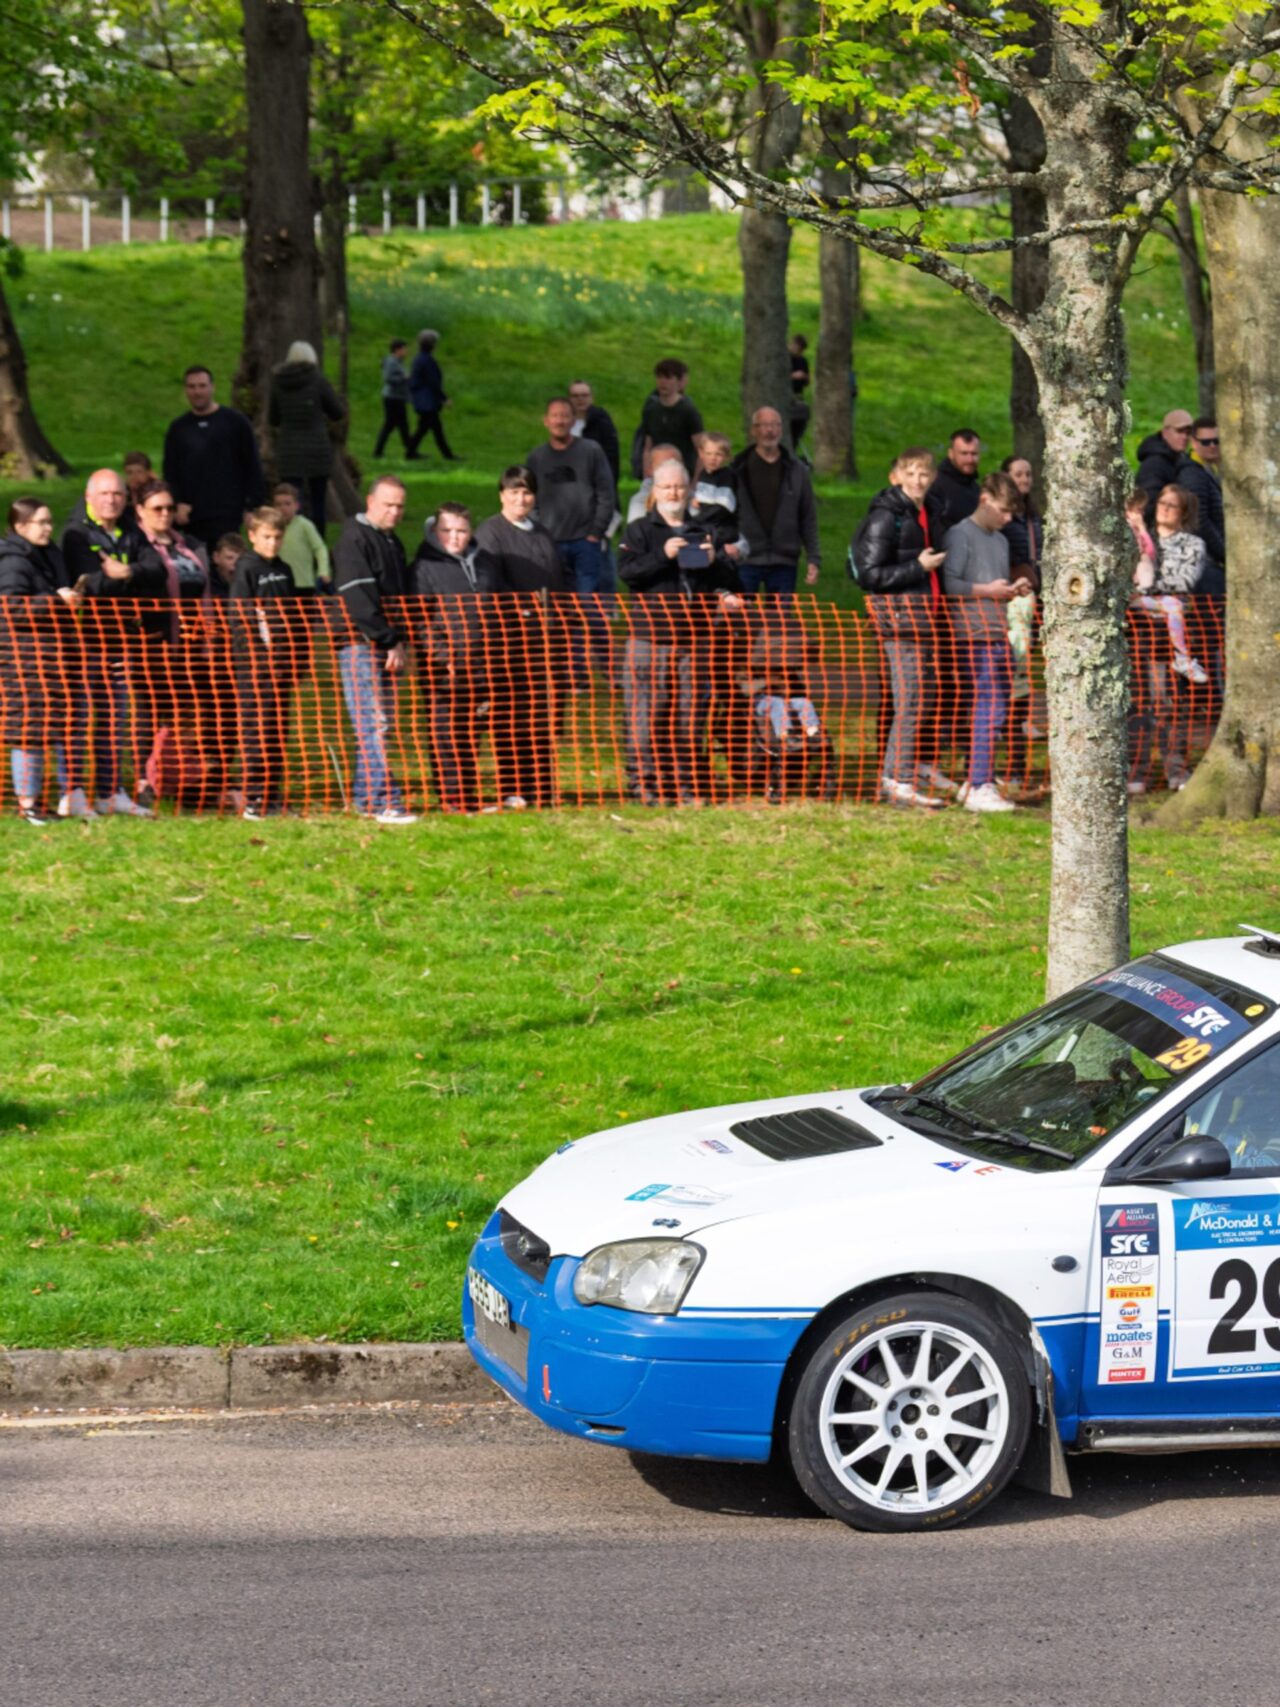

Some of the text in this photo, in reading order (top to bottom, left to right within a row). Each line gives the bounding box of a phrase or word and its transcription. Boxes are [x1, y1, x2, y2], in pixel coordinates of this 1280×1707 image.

[1156, 987, 1195, 1012] GROUP
[1155, 1037, 1212, 1071] 29
[1126, 1207, 1144, 1215] ASSET
[1126, 1213, 1155, 1221] ALLIANCE
[1200, 1214, 1259, 1230] McDonald
[1263, 1214, 1272, 1227] &
[1107, 1258, 1142, 1271] Royal
[1107, 1271, 1141, 1285] Aero
[1109, 1286, 1151, 1299] PIRELLI
[1119, 1308, 1141, 1317] Gulf
[1106, 1330, 1153, 1343] moates
[1110, 1369, 1143, 1378] MINTEX
